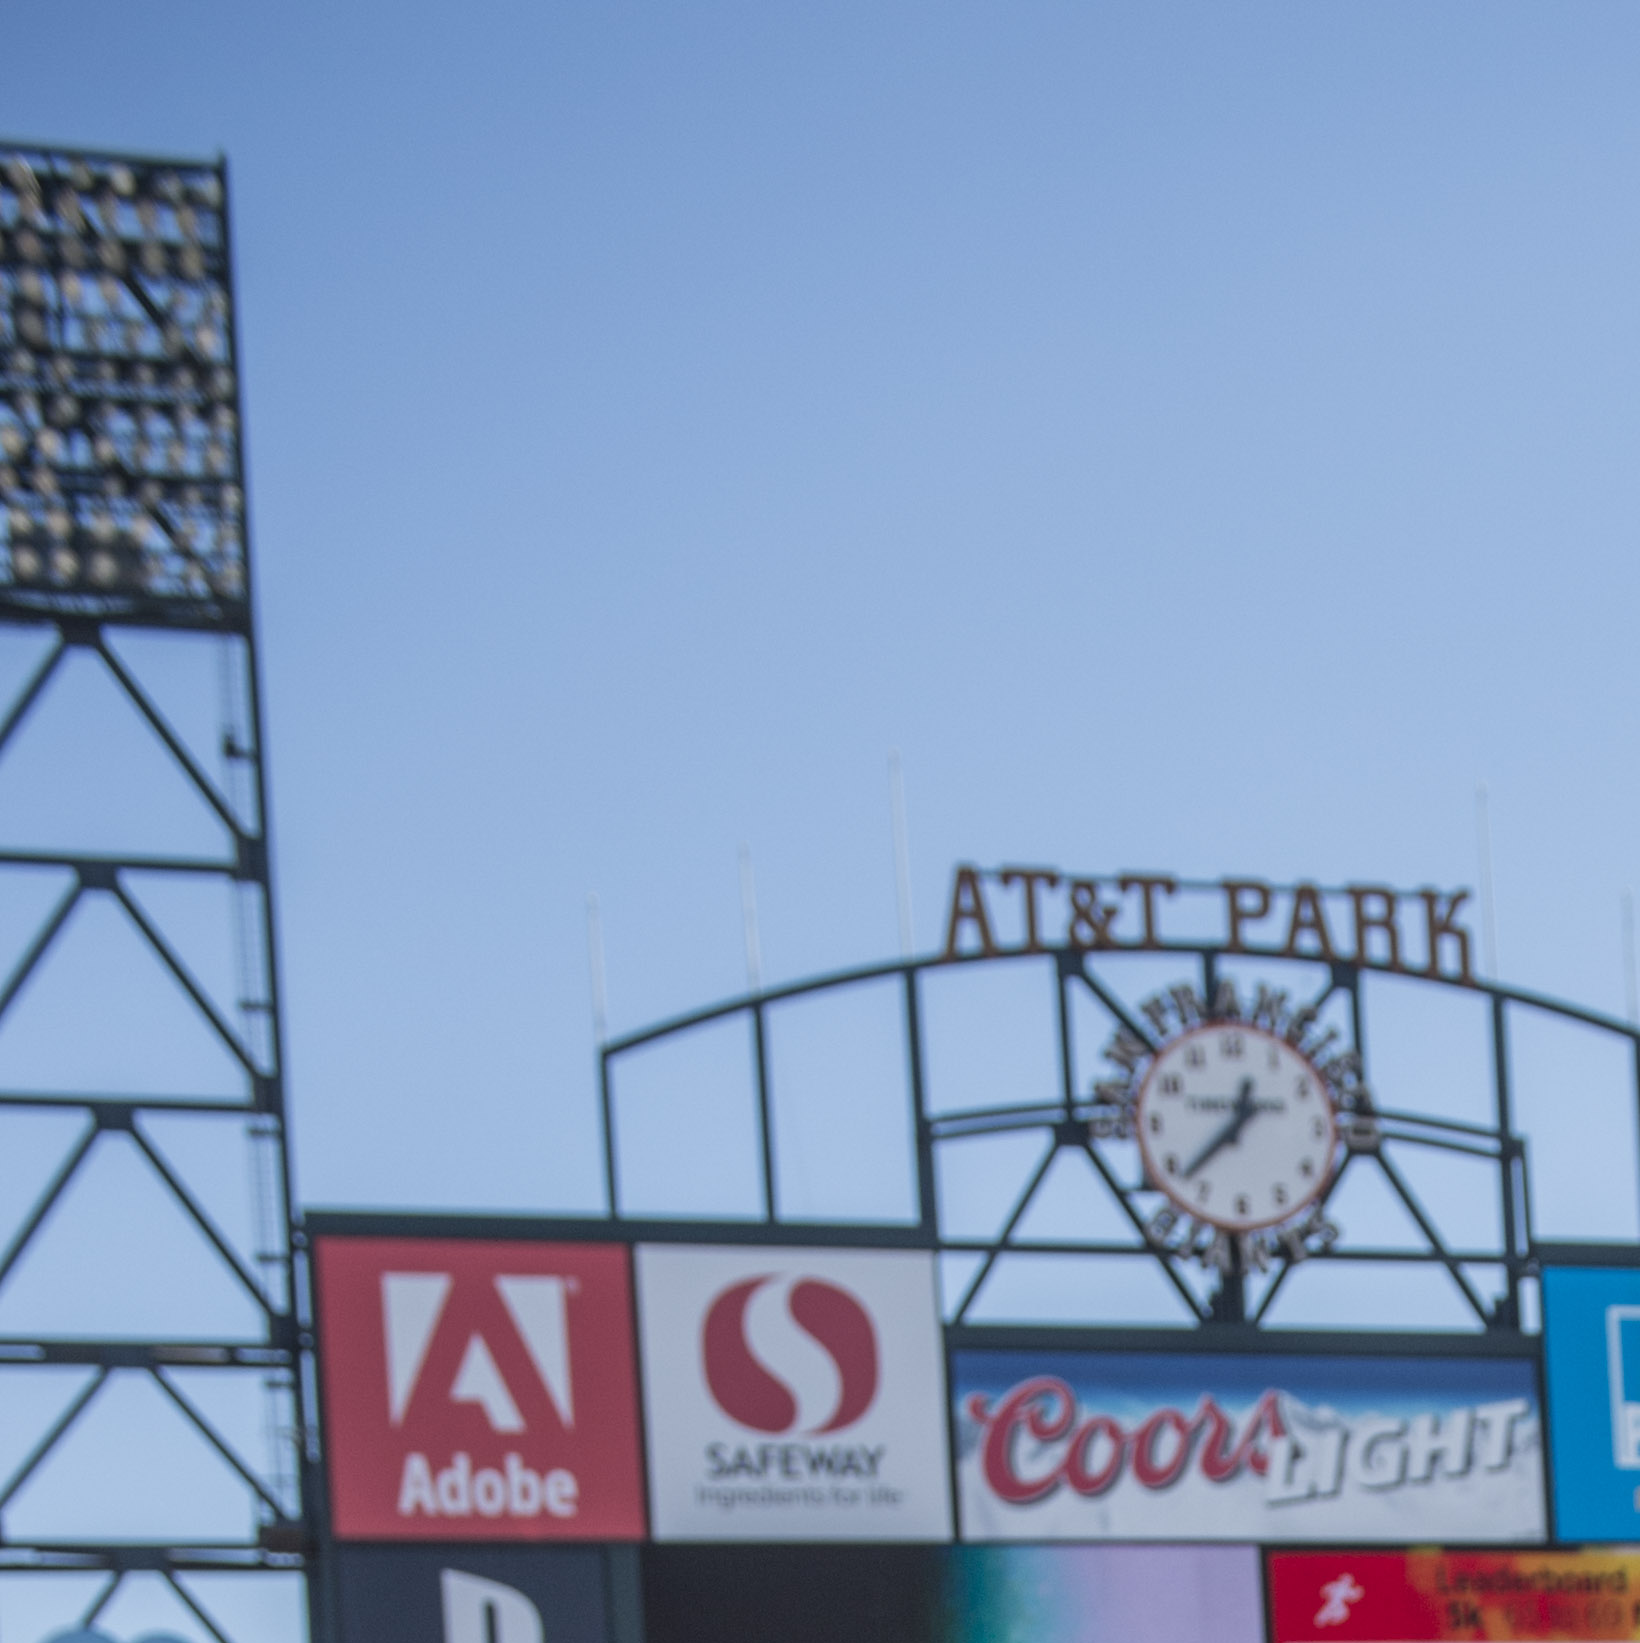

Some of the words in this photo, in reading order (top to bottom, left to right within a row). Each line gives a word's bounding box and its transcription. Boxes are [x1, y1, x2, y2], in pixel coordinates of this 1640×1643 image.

[940, 862, 1178, 963] AT&T
[1222, 876, 1474, 986] PARK
[705, 1442, 887, 1481] SAFEWAY
[967, 1374, 1289, 1504] Coors
[1266, 1398, 1530, 1504] LIGHT
[398, 1452, 580, 1519] Adobe
[1434, 1565, 1628, 1597] Leaderboard
